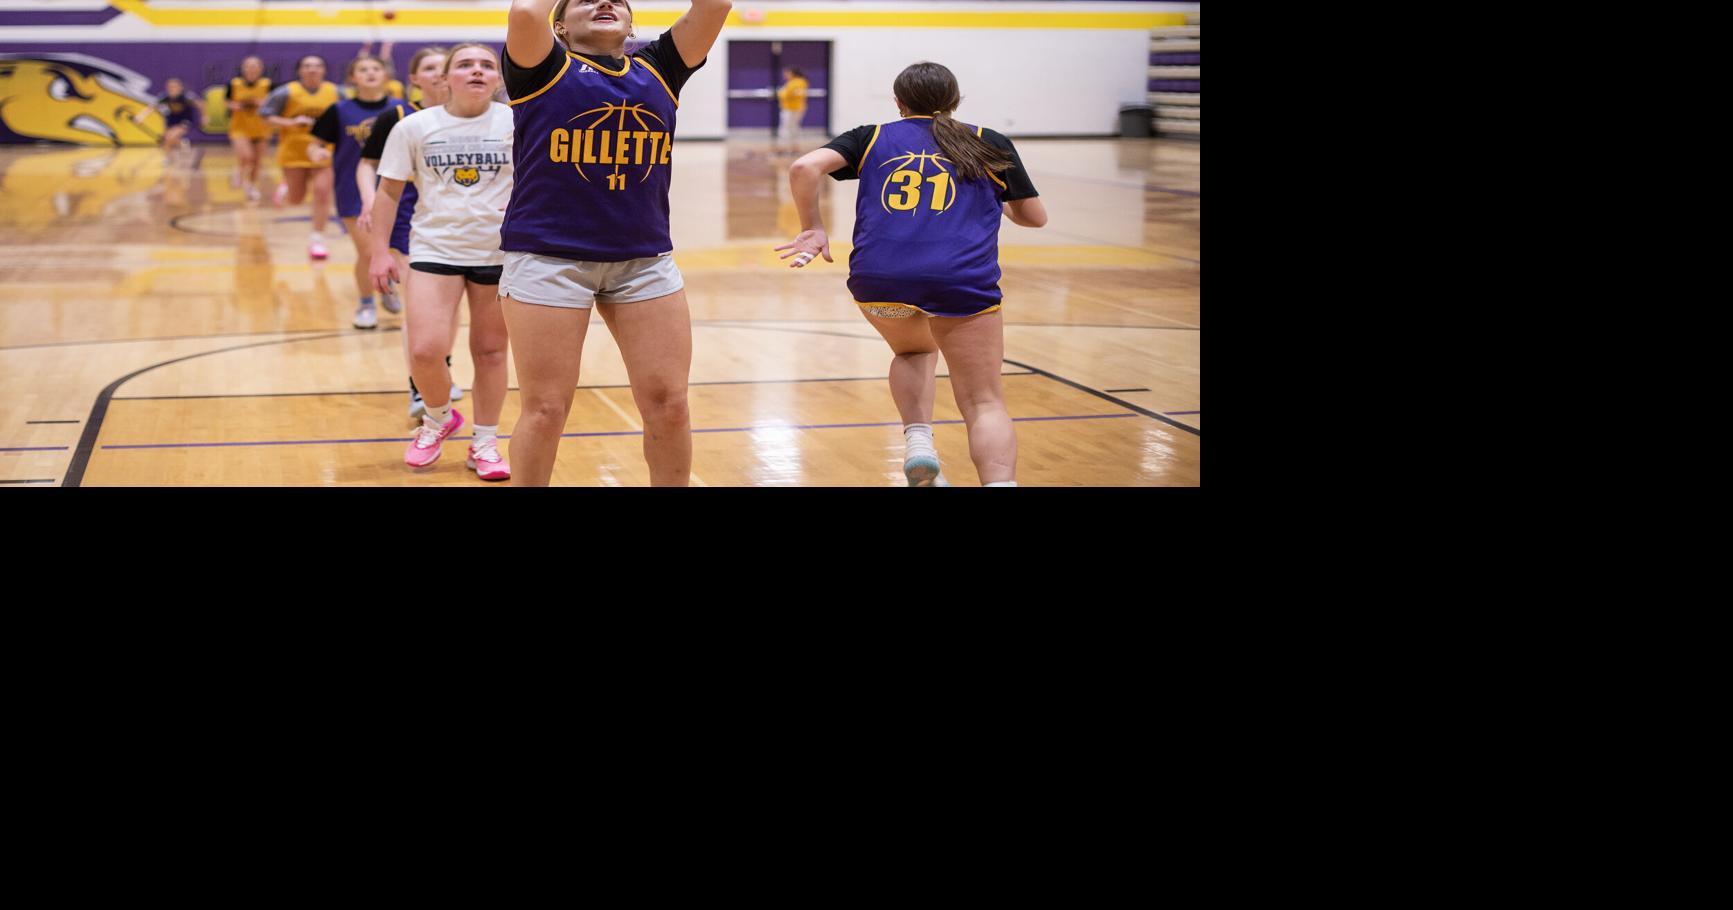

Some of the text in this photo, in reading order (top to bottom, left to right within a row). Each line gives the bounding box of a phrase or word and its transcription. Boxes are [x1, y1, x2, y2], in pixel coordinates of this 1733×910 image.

[424, 152, 510, 167] VOLLEYBALL
[549, 128, 671, 165] GILLETTE
[606, 173, 626, 190] 11
[888, 170, 950, 211] 31
